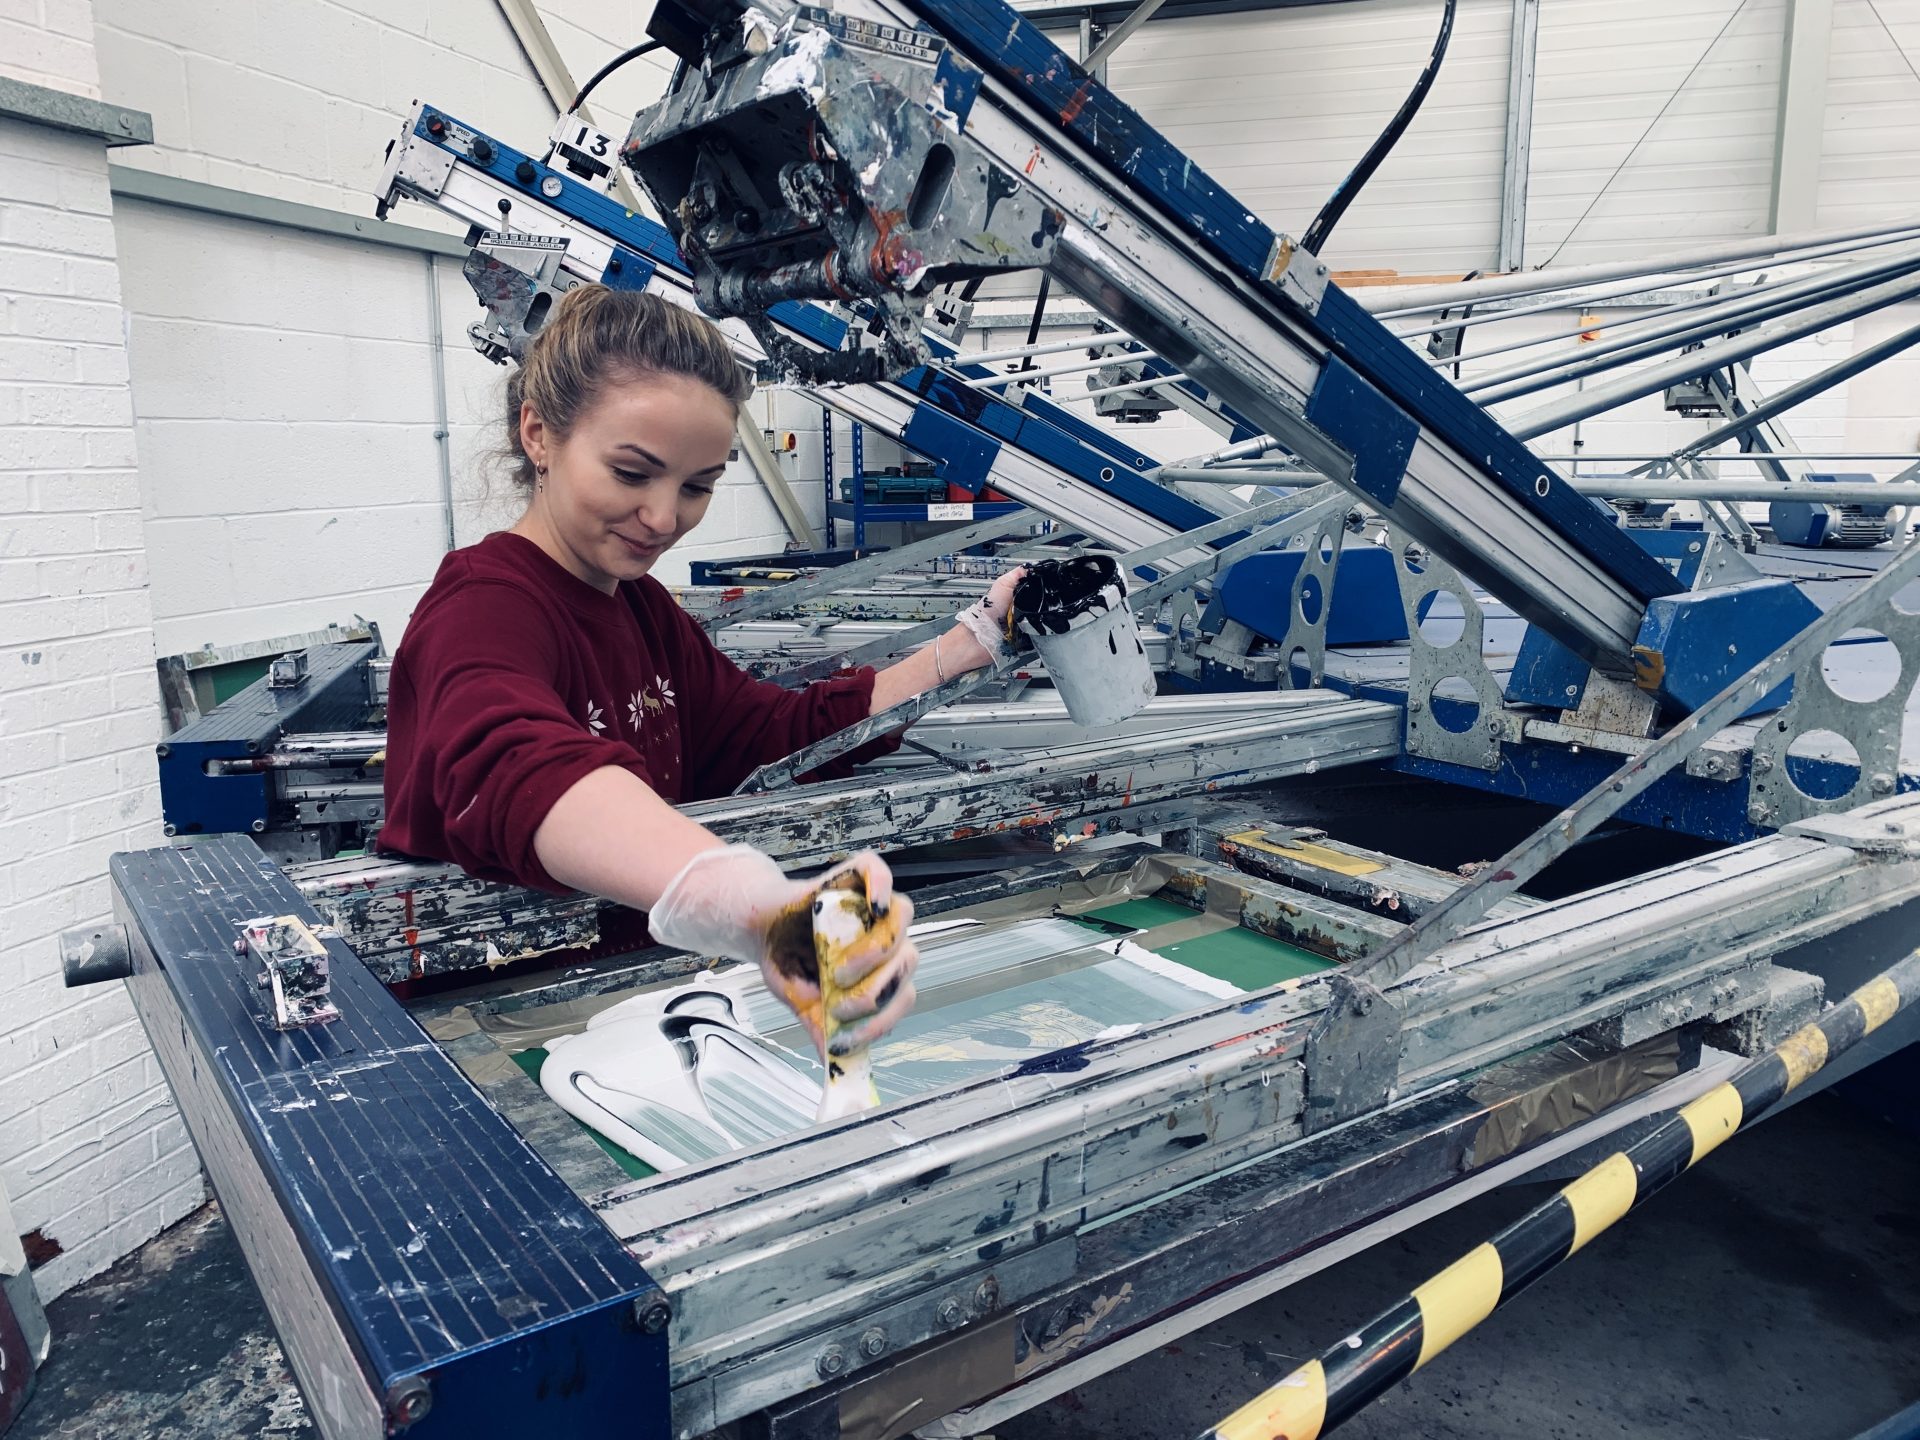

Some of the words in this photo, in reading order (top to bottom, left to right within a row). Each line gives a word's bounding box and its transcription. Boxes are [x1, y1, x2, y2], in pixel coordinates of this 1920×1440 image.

[885, 40, 928, 58] ANGLE
[455, 126, 471, 137] SPEED
[575, 127, 611, 156] 13
